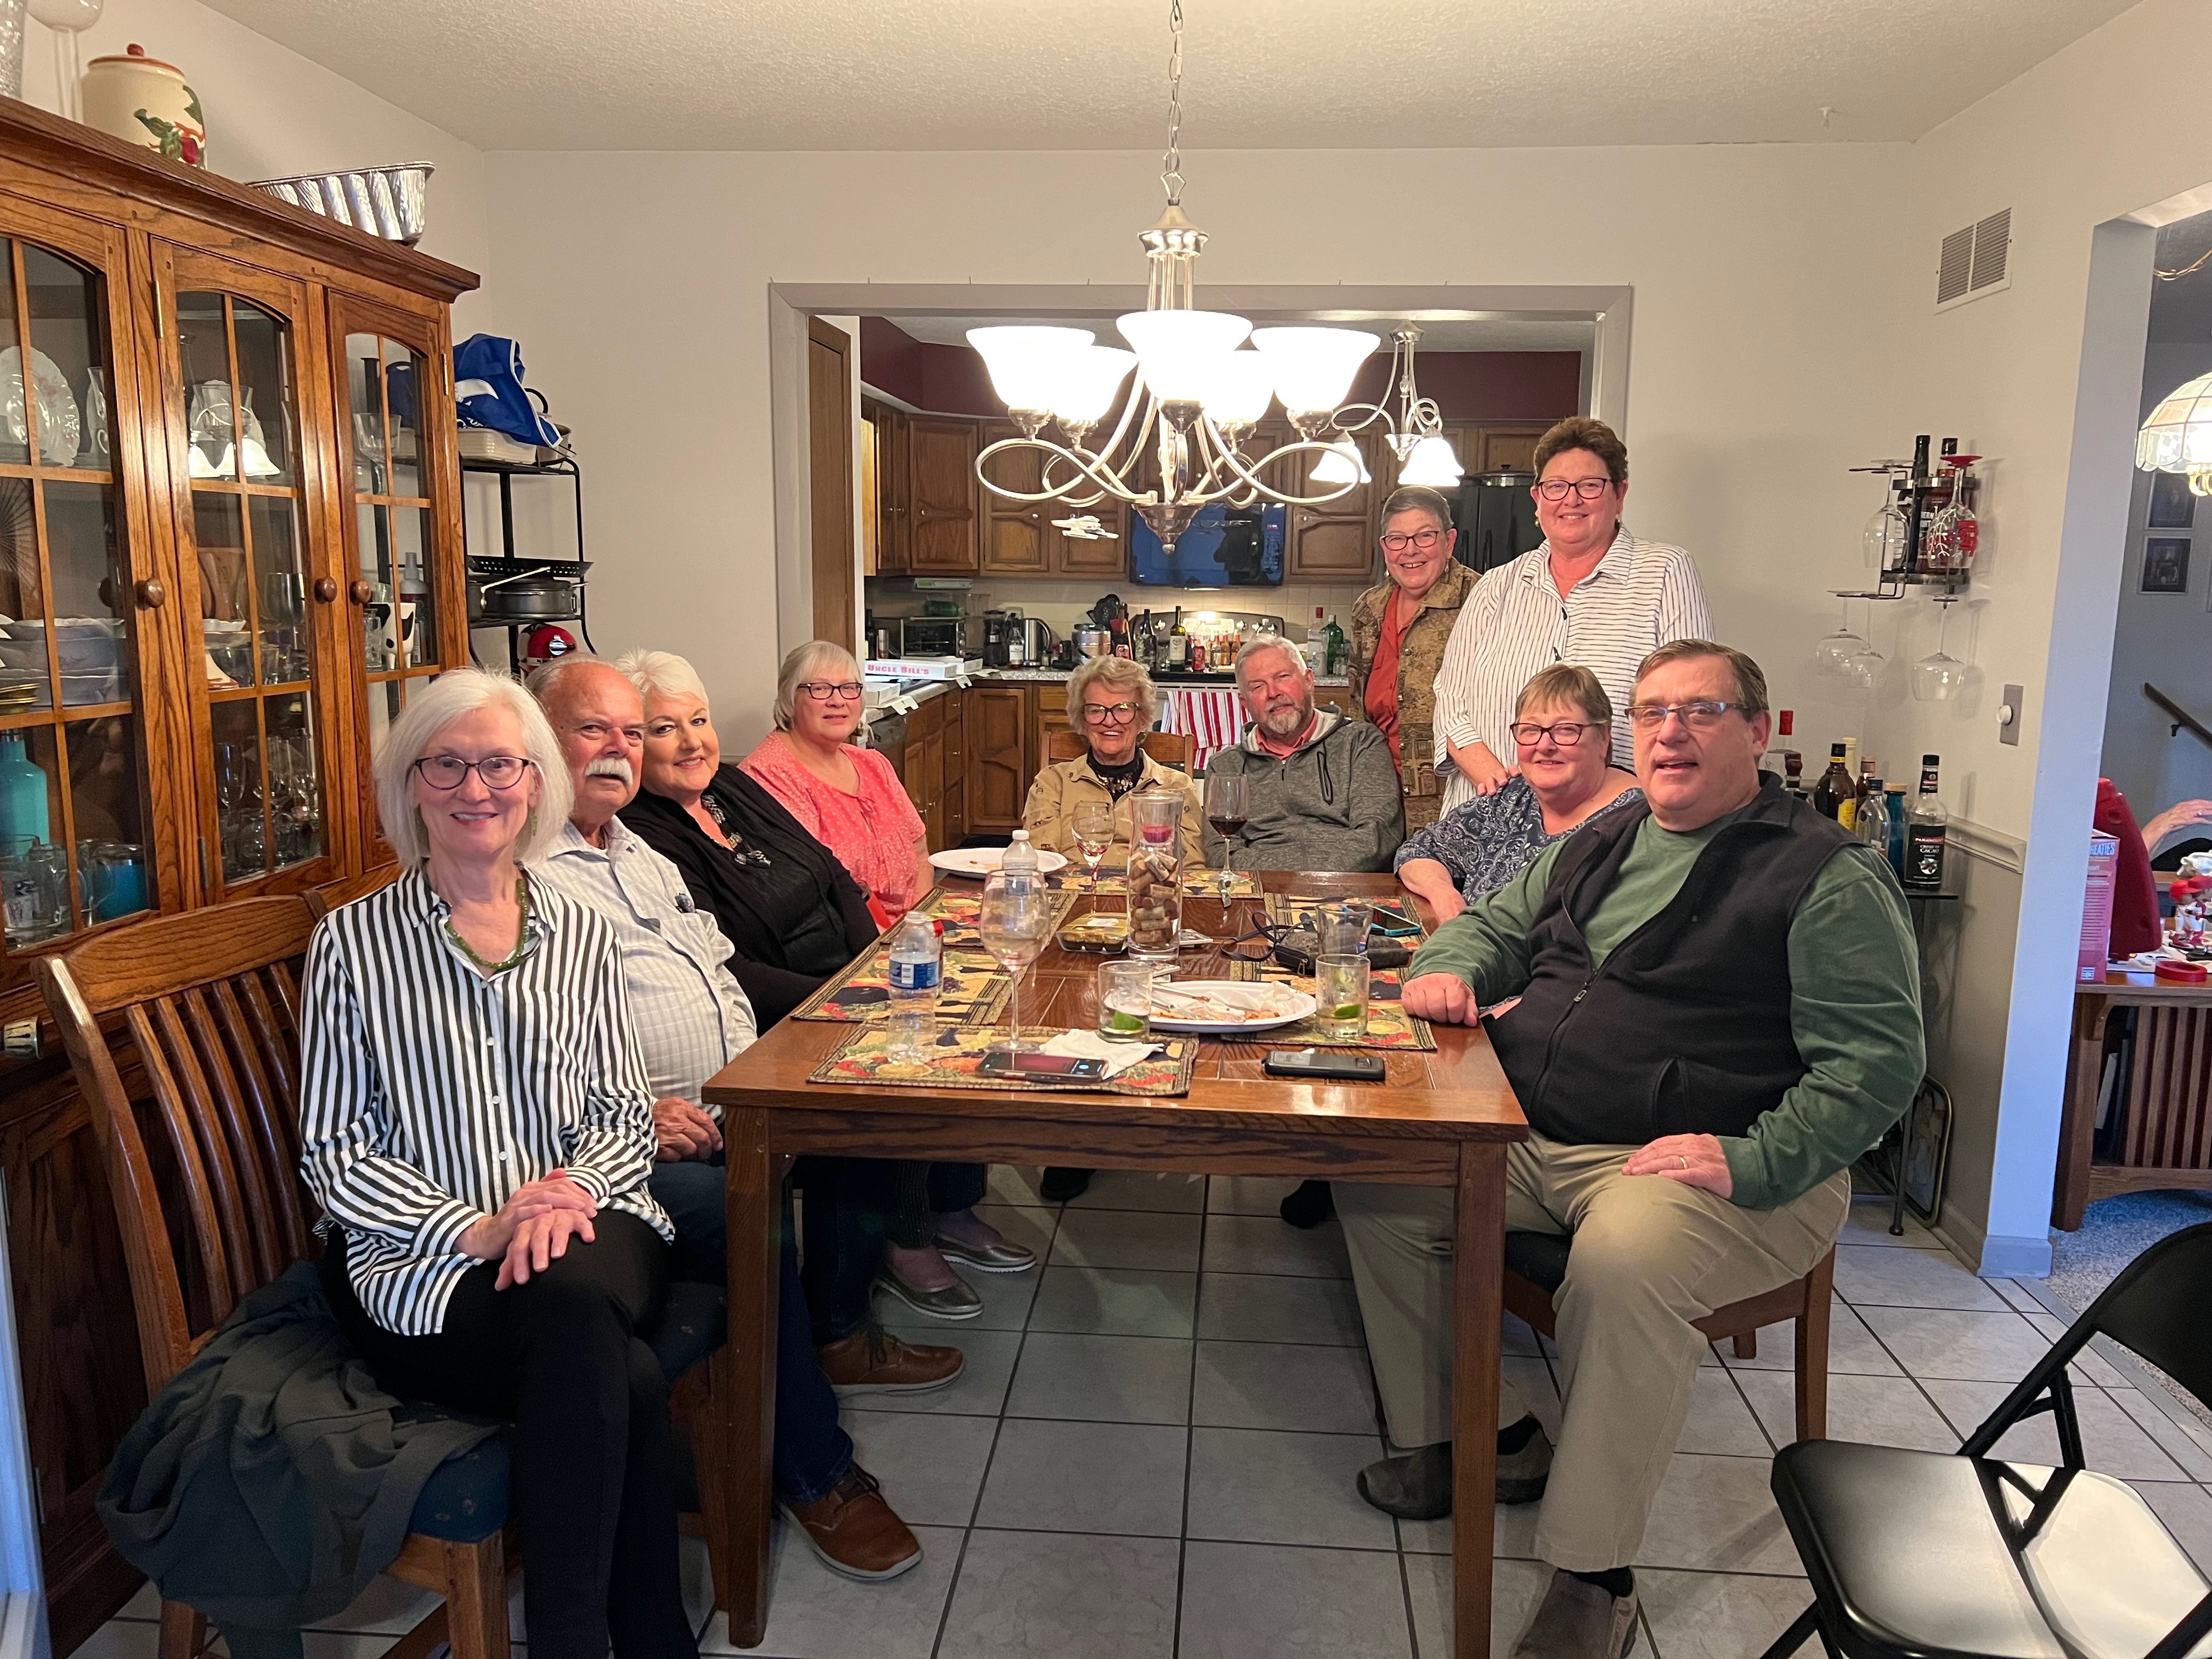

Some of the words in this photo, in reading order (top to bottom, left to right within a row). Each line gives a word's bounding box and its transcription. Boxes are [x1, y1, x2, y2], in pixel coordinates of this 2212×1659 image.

[868, 664, 896, 673] UNCLE
[901, 666, 929, 675] BILL'S
[2090, 842, 2115, 855] HEATIES
